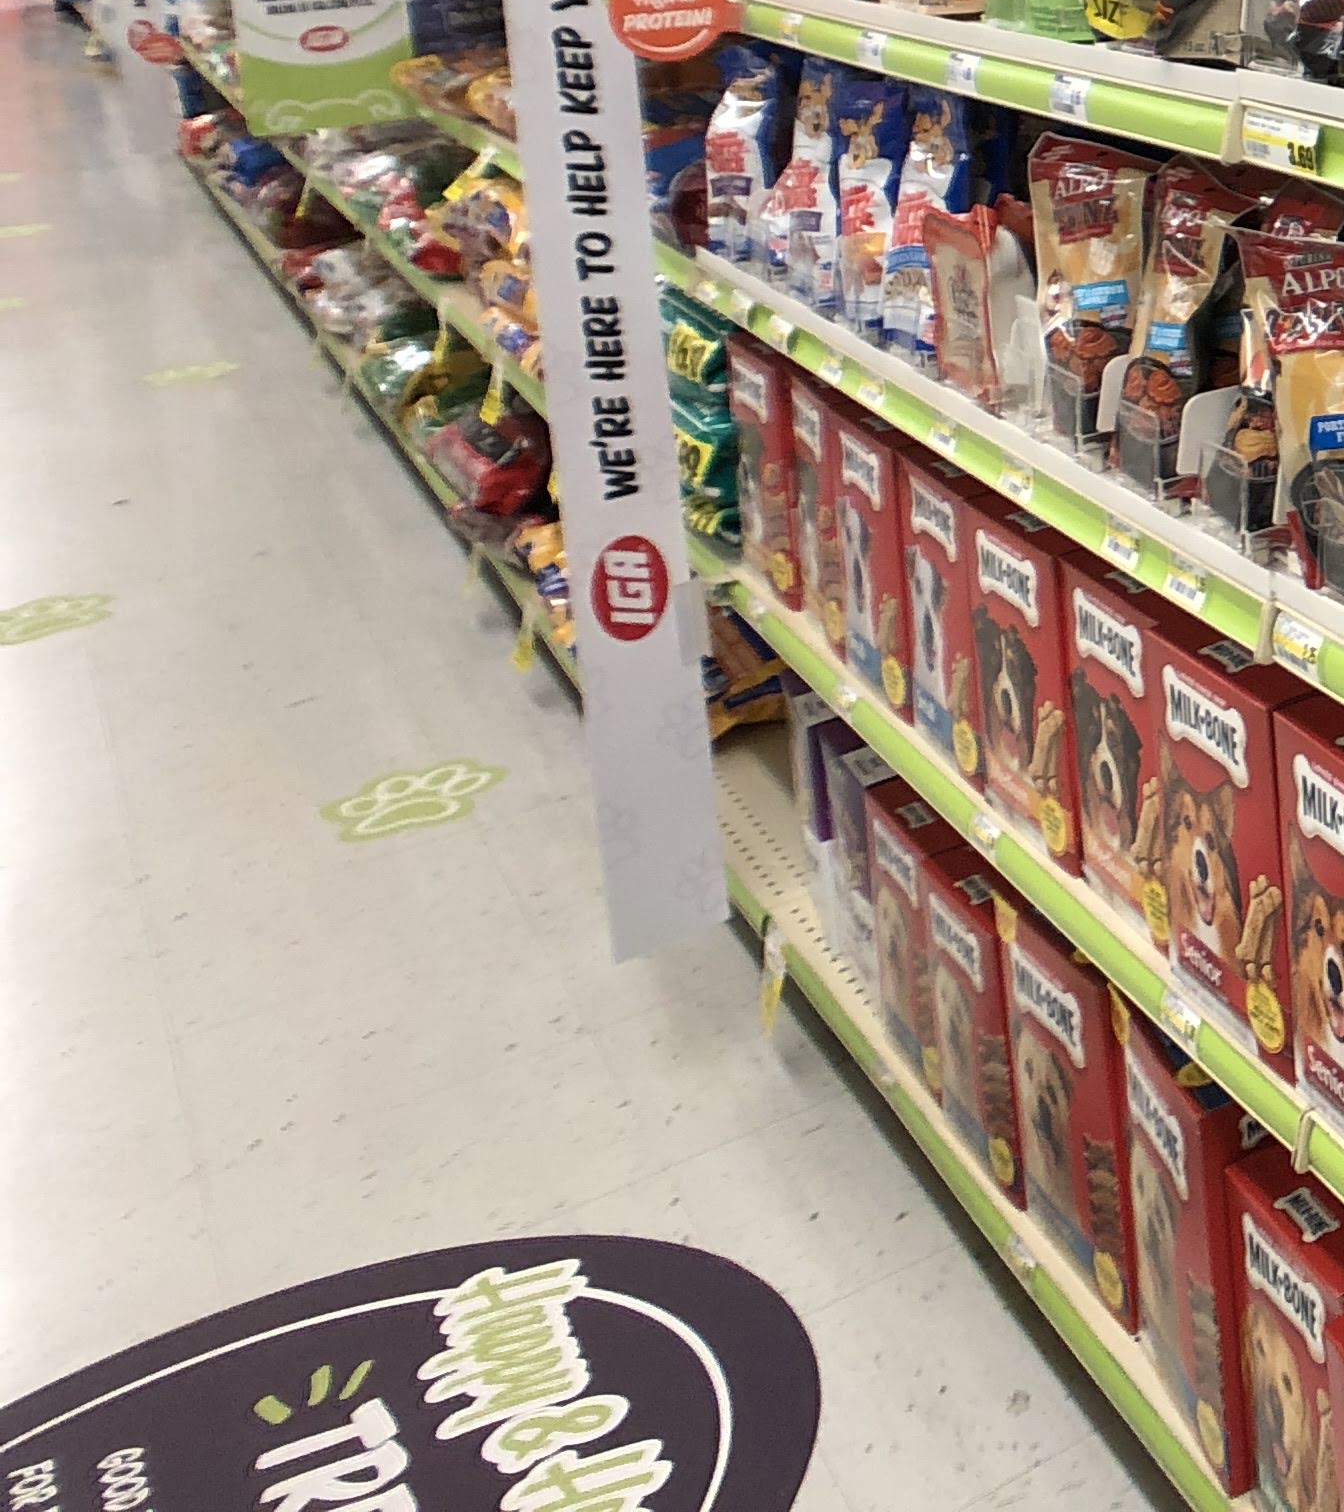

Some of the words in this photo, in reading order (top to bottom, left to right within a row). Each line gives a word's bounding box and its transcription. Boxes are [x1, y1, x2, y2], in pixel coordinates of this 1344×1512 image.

[549, 24, 600, 124] KEEP
[558, 129, 609, 226] HELP
[574, 229, 614, 284] TO
[580, 294, 625, 381] HERE
[588, 394, 640, 502] WE'RE
[605, 546, 657, 627] IGA
